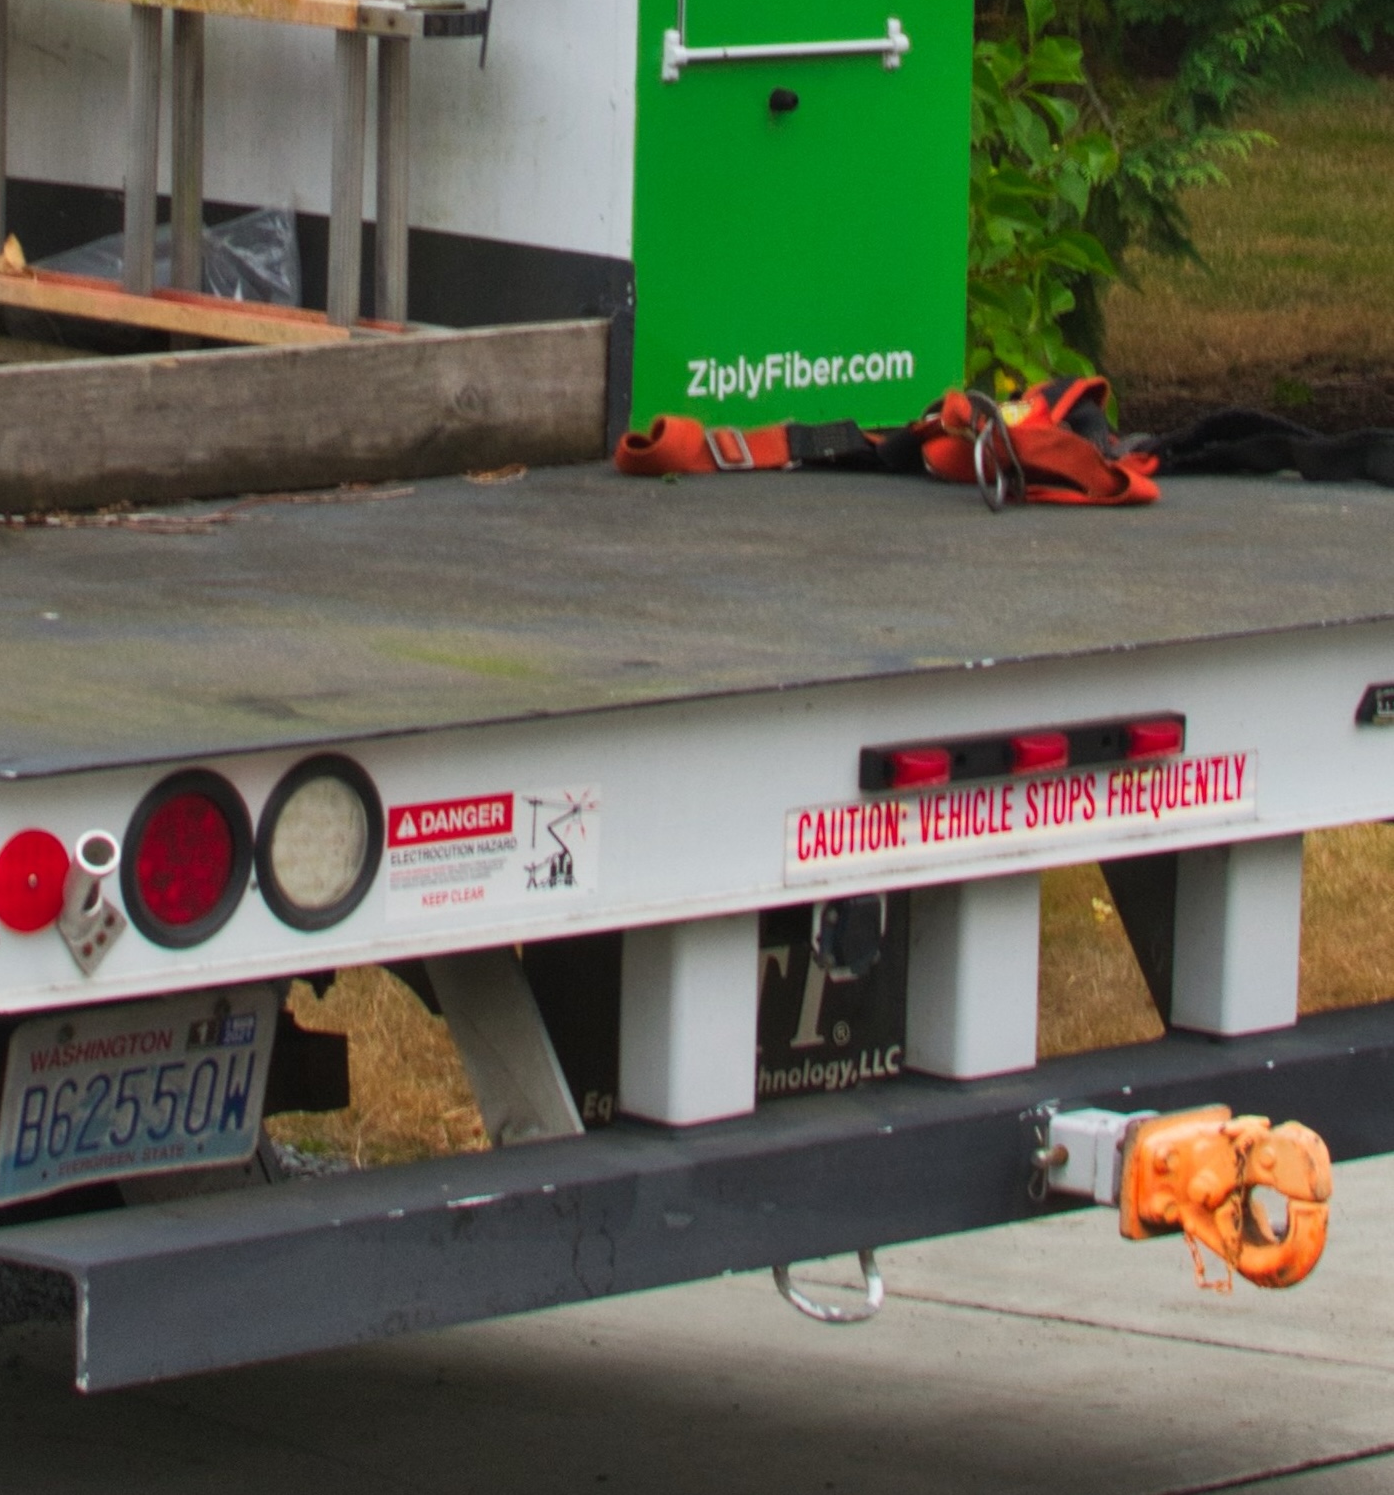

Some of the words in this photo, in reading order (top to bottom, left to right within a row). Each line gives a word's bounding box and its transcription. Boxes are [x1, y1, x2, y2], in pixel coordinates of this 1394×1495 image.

[687, 350, 913, 401] ZiplyFiber.com
[420, 803, 504, 835] DANGER
[797, 801, 908, 862] CAUTION:
[919, 787, 1013, 843] VEHICLE
[1025, 773, 1096, 829] STOPS
[1107, 754, 1247, 820] FREQUENTLY
[390, 843, 474, 866] ELECTROCUTION
[477, 837, 518, 854] HAZARD
[421, 890, 449, 907] KEEP
[451, 886, 485, 904] CLEAR
[29, 1029, 173, 1073] WASHINGTON
